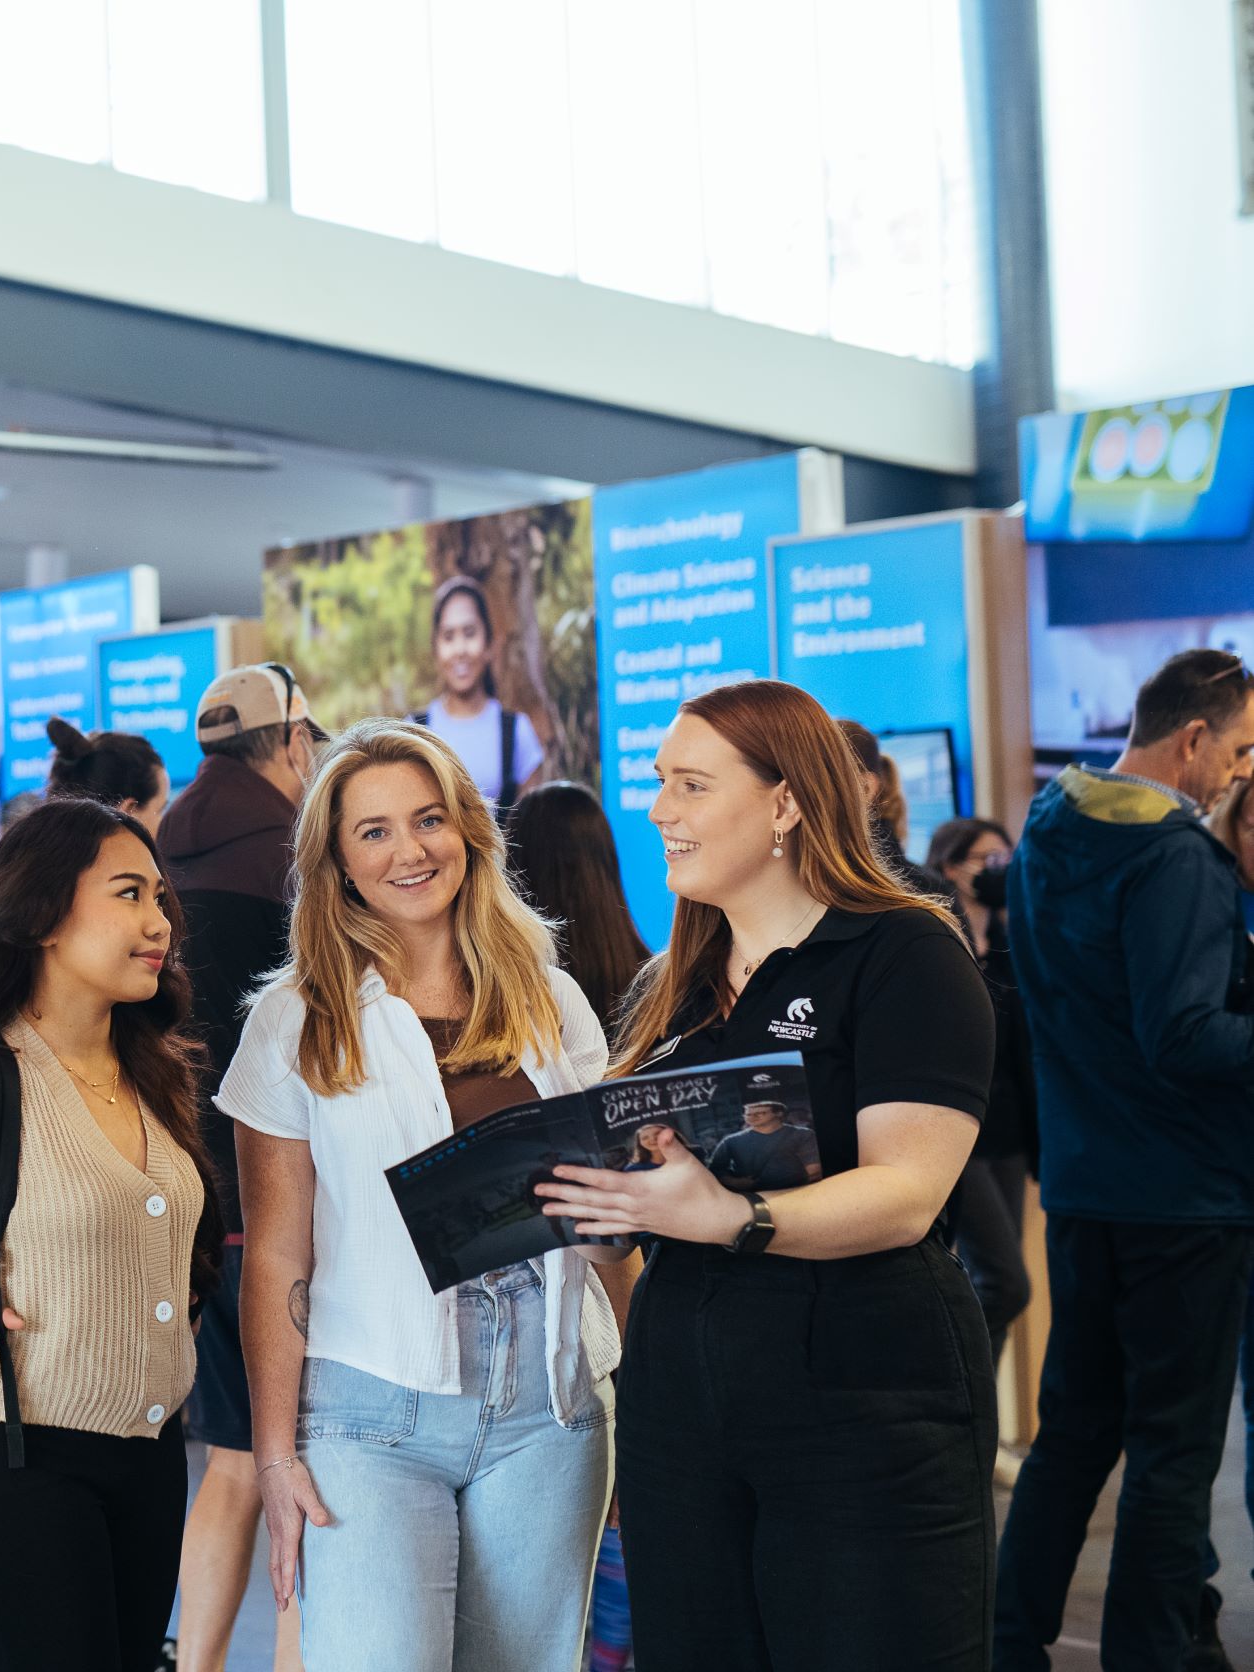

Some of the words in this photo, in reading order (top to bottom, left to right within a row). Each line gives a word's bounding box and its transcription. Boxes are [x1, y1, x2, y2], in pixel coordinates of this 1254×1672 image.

[768, 1024, 816, 1039] NEWCASTLE
[602, 1084, 660, 1104] CENTRAL
[666, 1076, 717, 1093] COAST
[604, 1093, 661, 1123] OPEN
[671, 1084, 719, 1107] DAY
